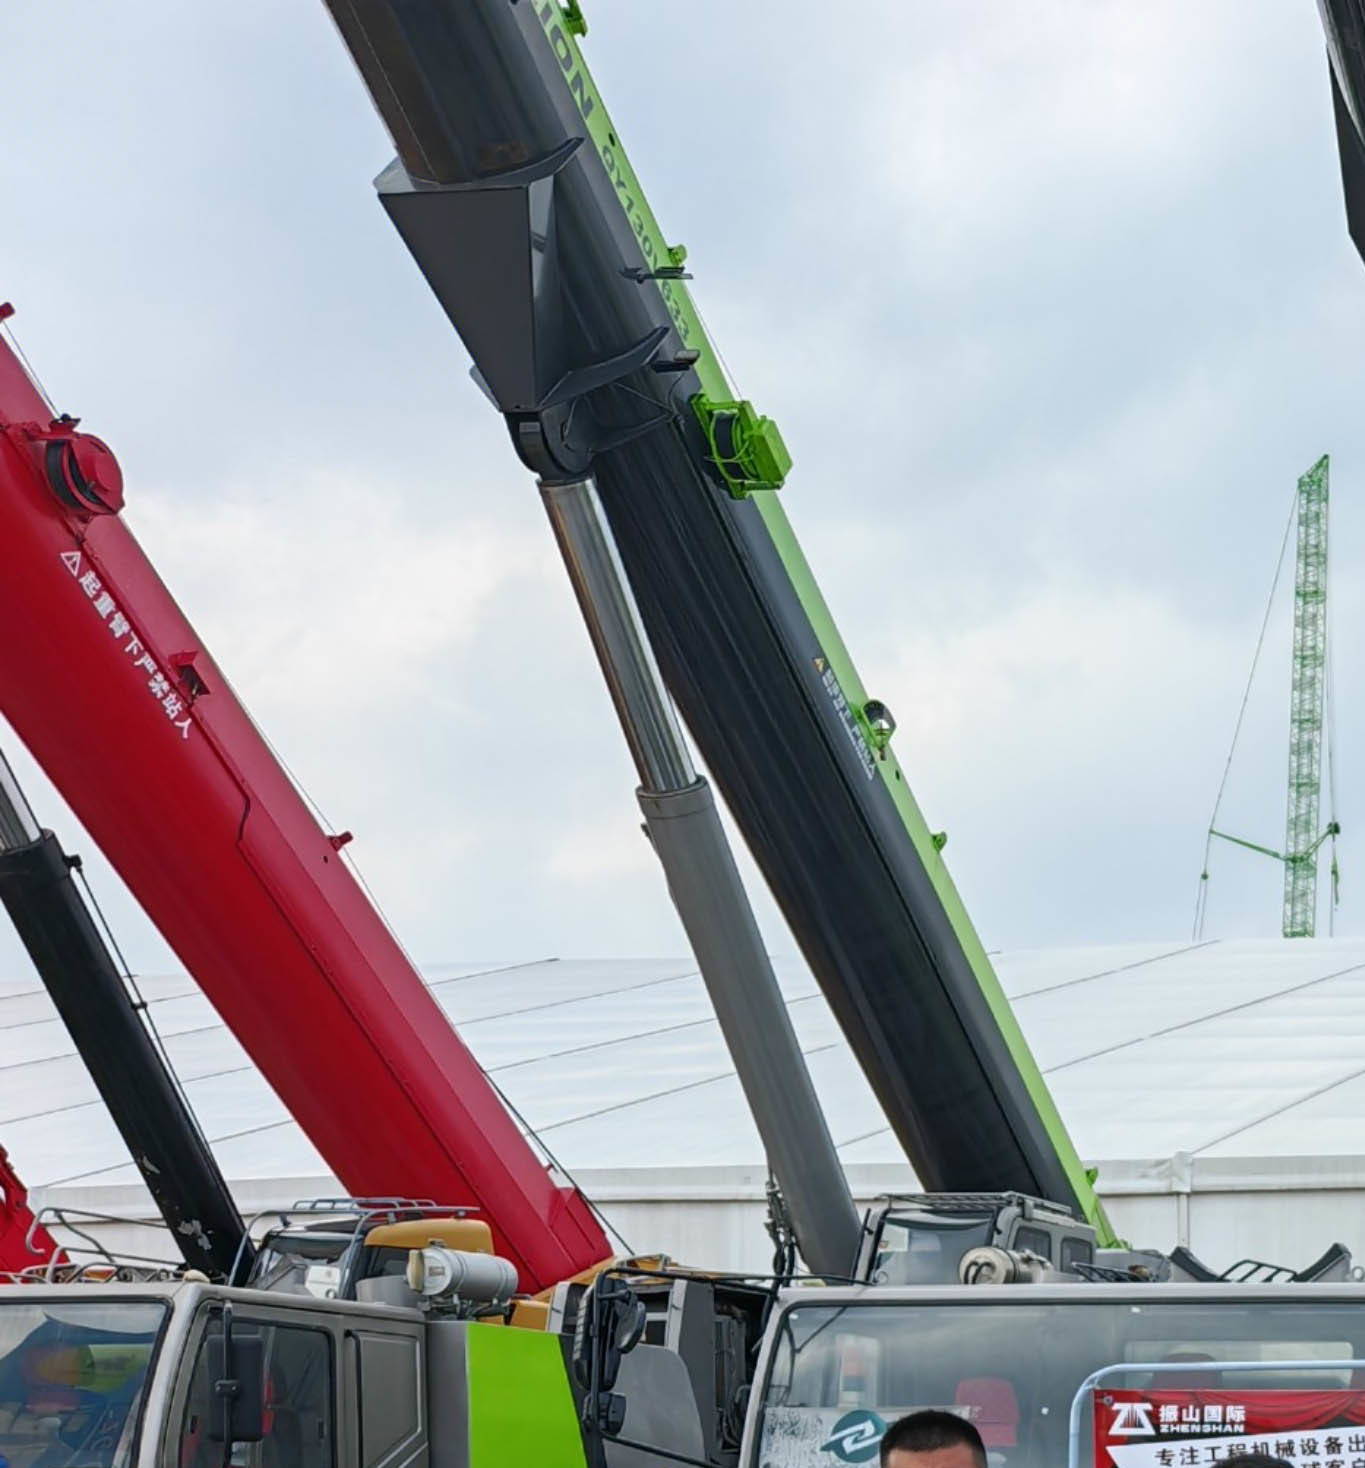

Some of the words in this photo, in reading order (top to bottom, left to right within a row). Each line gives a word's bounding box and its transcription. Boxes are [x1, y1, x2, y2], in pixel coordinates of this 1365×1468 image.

[538, 0, 594, 120] ION
[78, 570, 192, 739] 起重臂下严禁站人
[1159, 1405, 1246, 1422] 振山国际
[1159, 1424, 1245, 1433] ZHENSHAN
